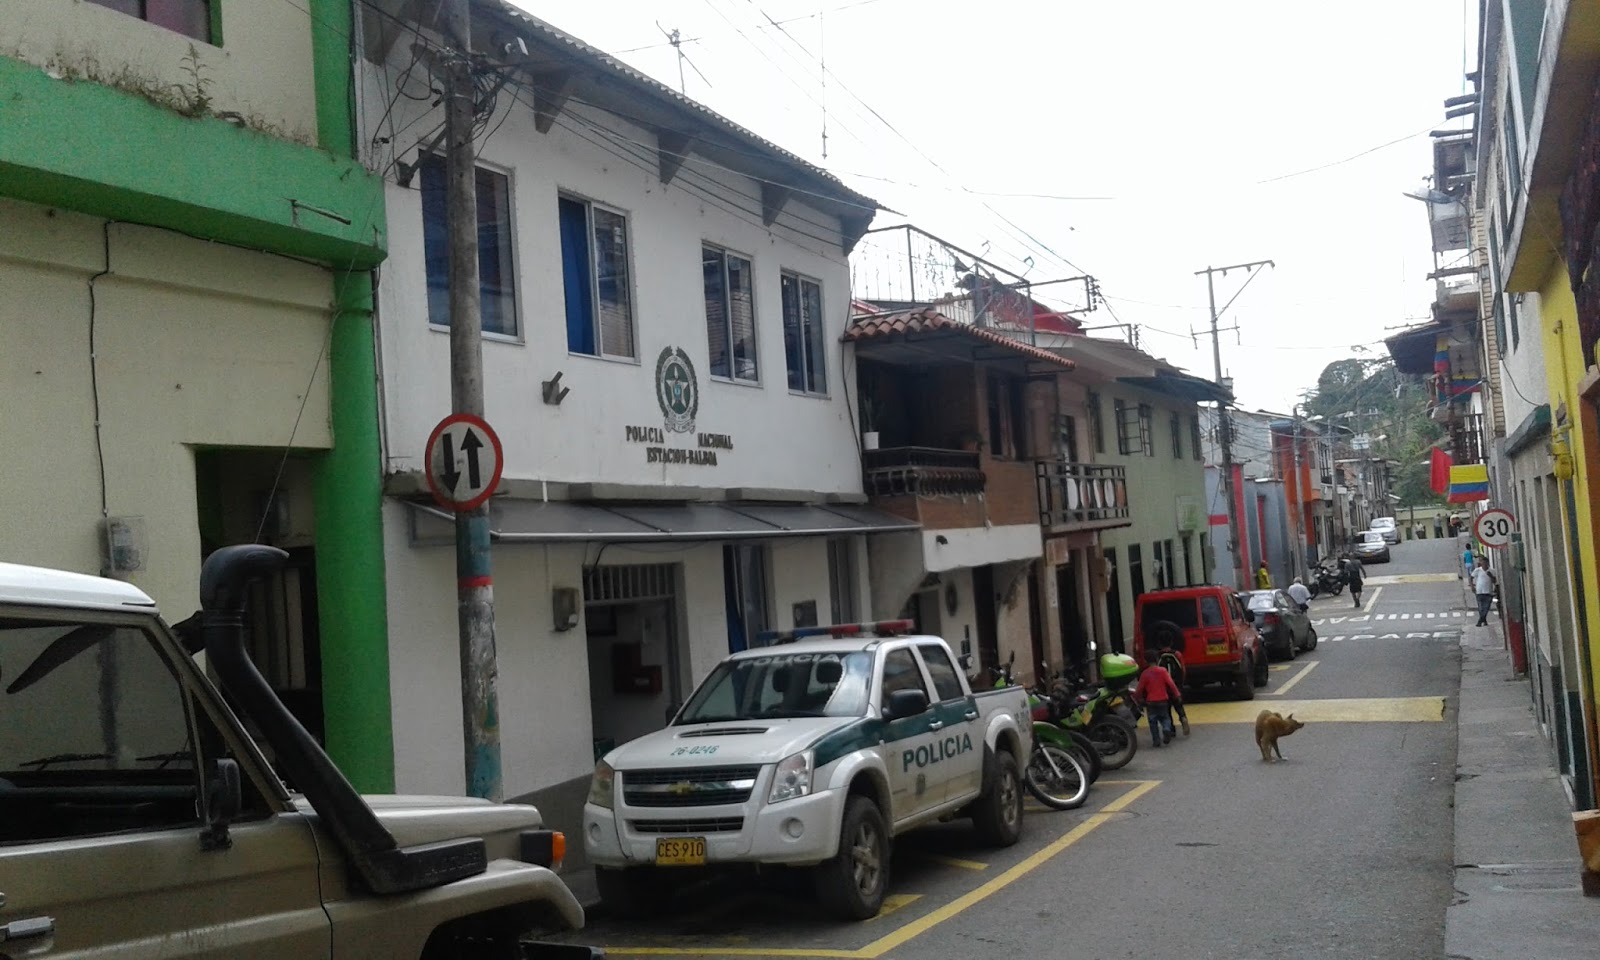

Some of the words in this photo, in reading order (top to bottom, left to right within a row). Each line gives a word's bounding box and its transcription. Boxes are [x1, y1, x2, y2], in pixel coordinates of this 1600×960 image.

[625, 426, 664, 443] POLICIA
[698, 432, 733, 449] NACIONAL
[1484, 518, 1509, 537] 30
[737, 653, 840, 669] POLICIA
[902, 732, 973, 772] POLICIA
